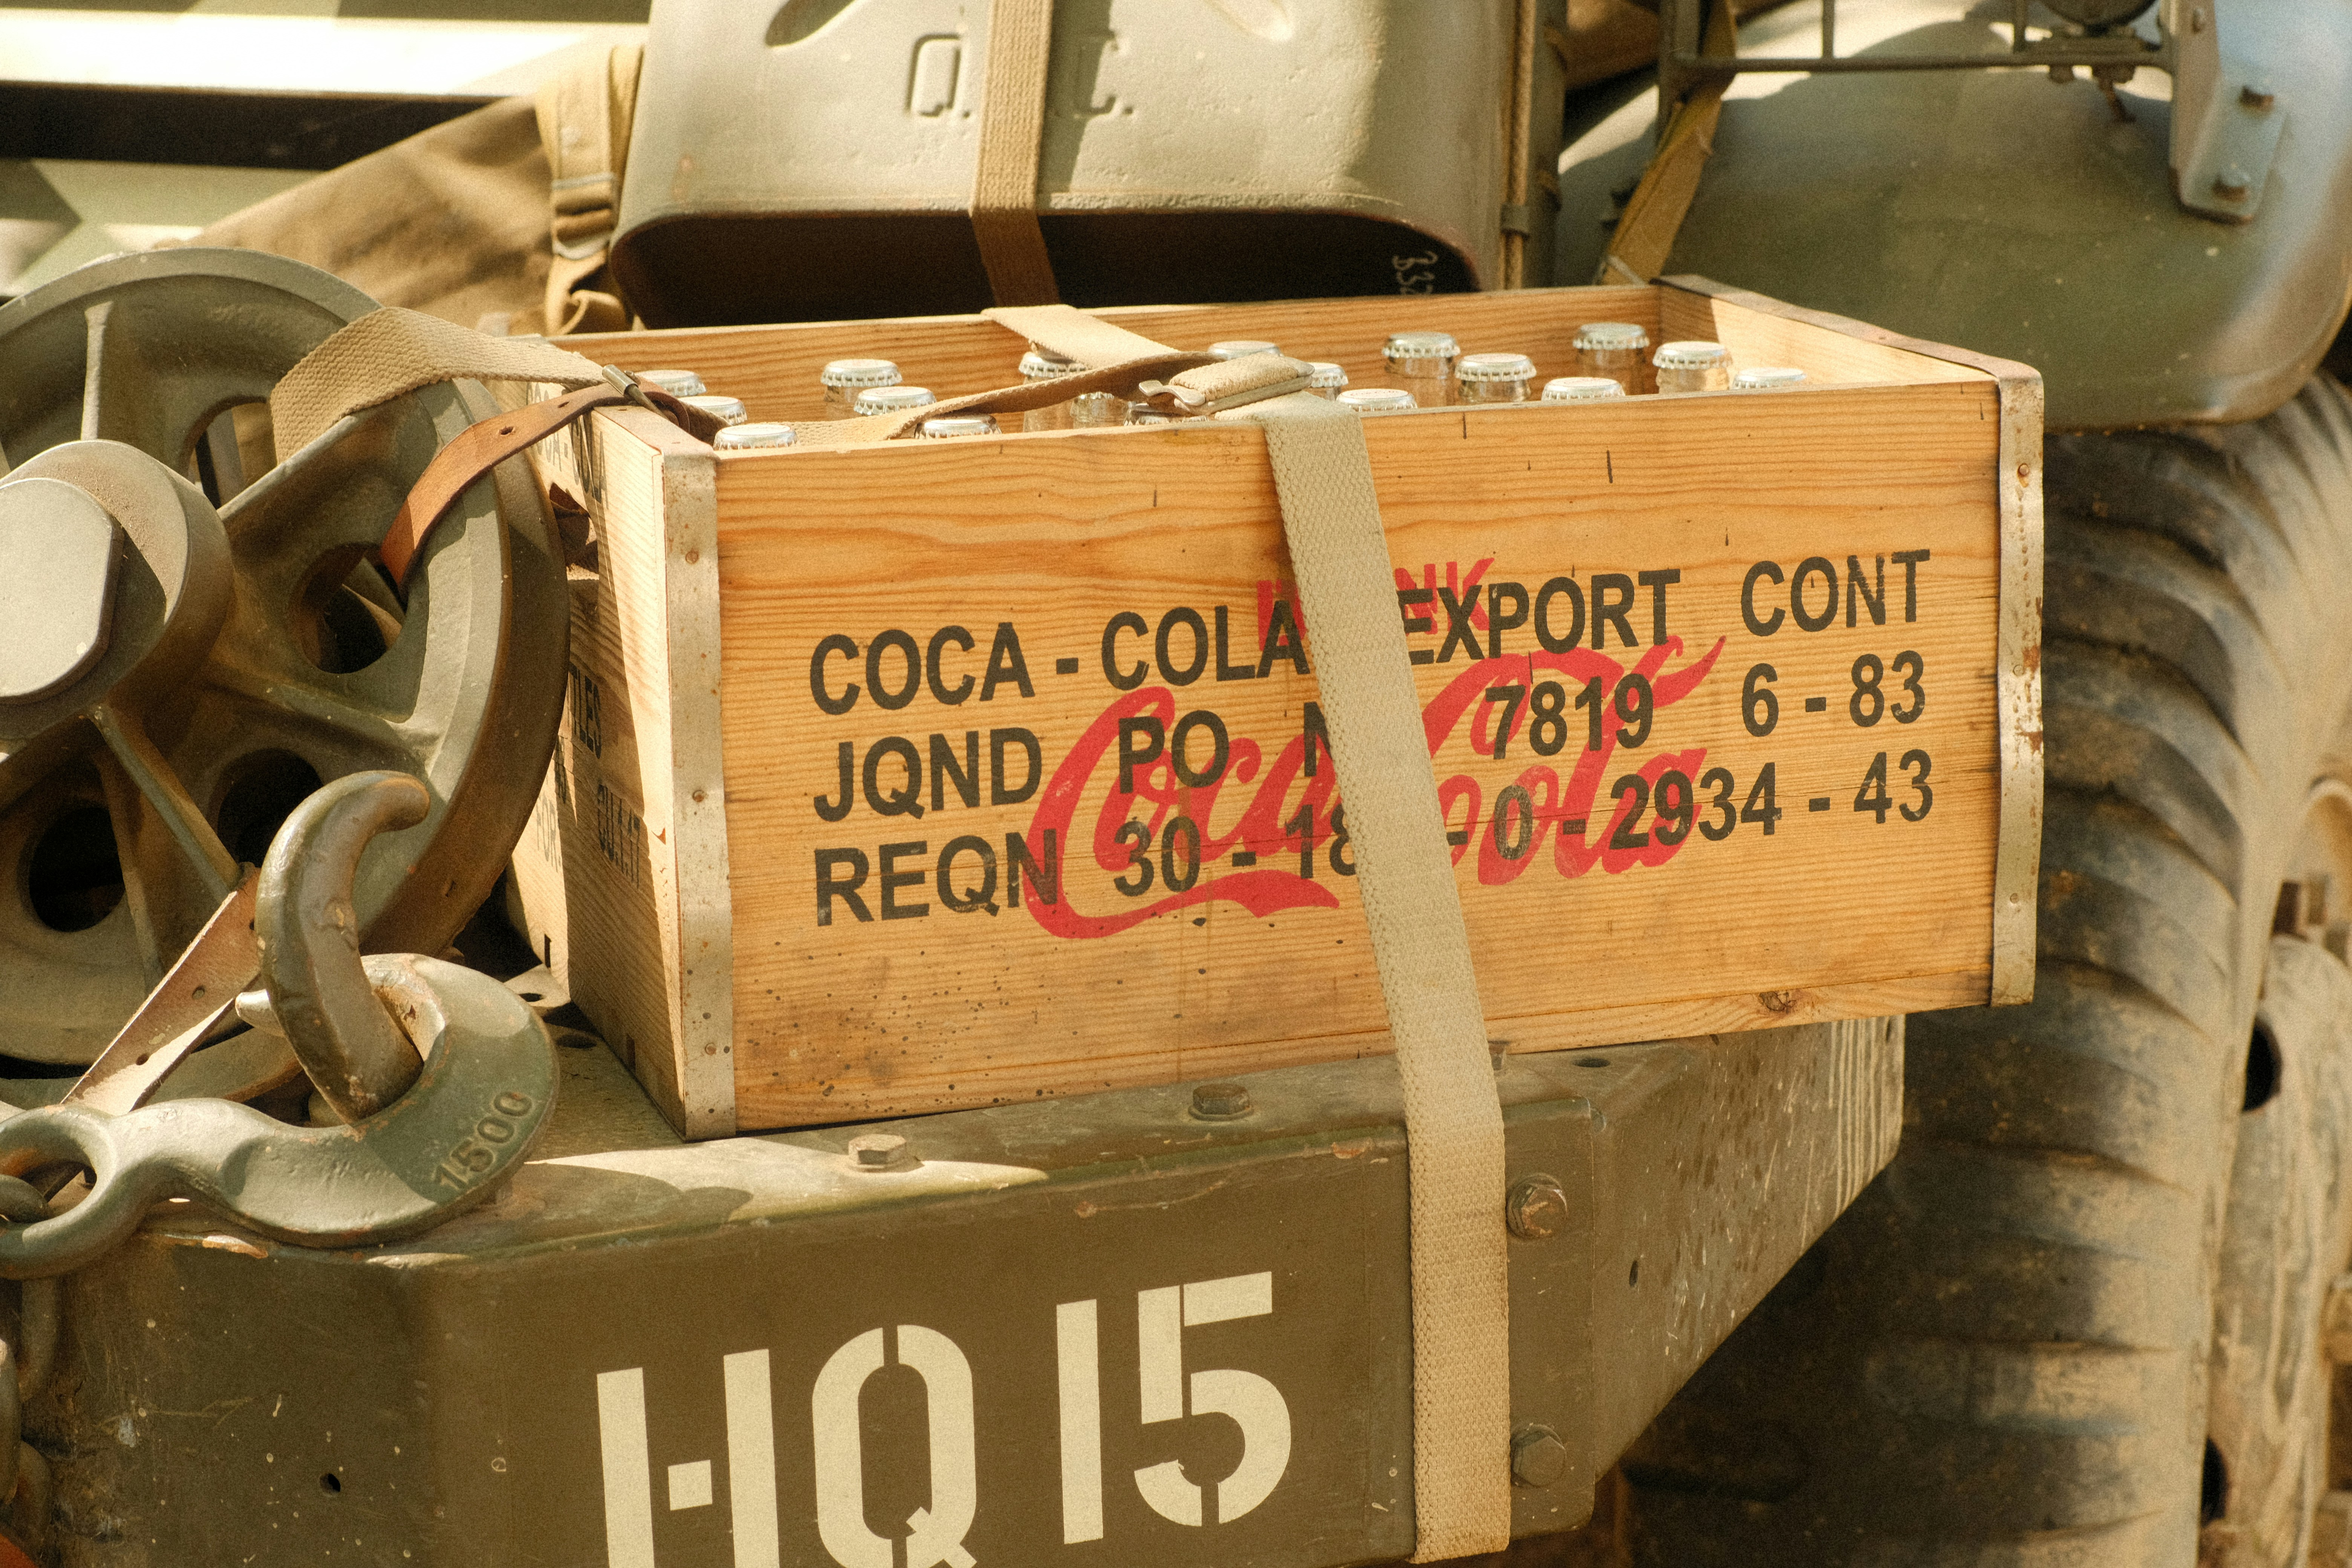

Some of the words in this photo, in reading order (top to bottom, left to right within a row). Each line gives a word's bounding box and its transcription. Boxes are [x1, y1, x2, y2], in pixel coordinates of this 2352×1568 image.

[1256, 557, 1495, 652] DNK
[1396, 568, 1681, 666] EXPORT
[1741, 549, 1930, 637] CONT
[813, 726, 1042, 822] JQND
[1119, 710, 1230, 794] PO
[1484, 673, 1655, 760] 7819
[813, 829, 1057, 926] REQN
[432, 1092, 533, 1190] 1500
[596, 1324, 977, 1568] HQ
[1057, 1271, 1292, 1545] 15
